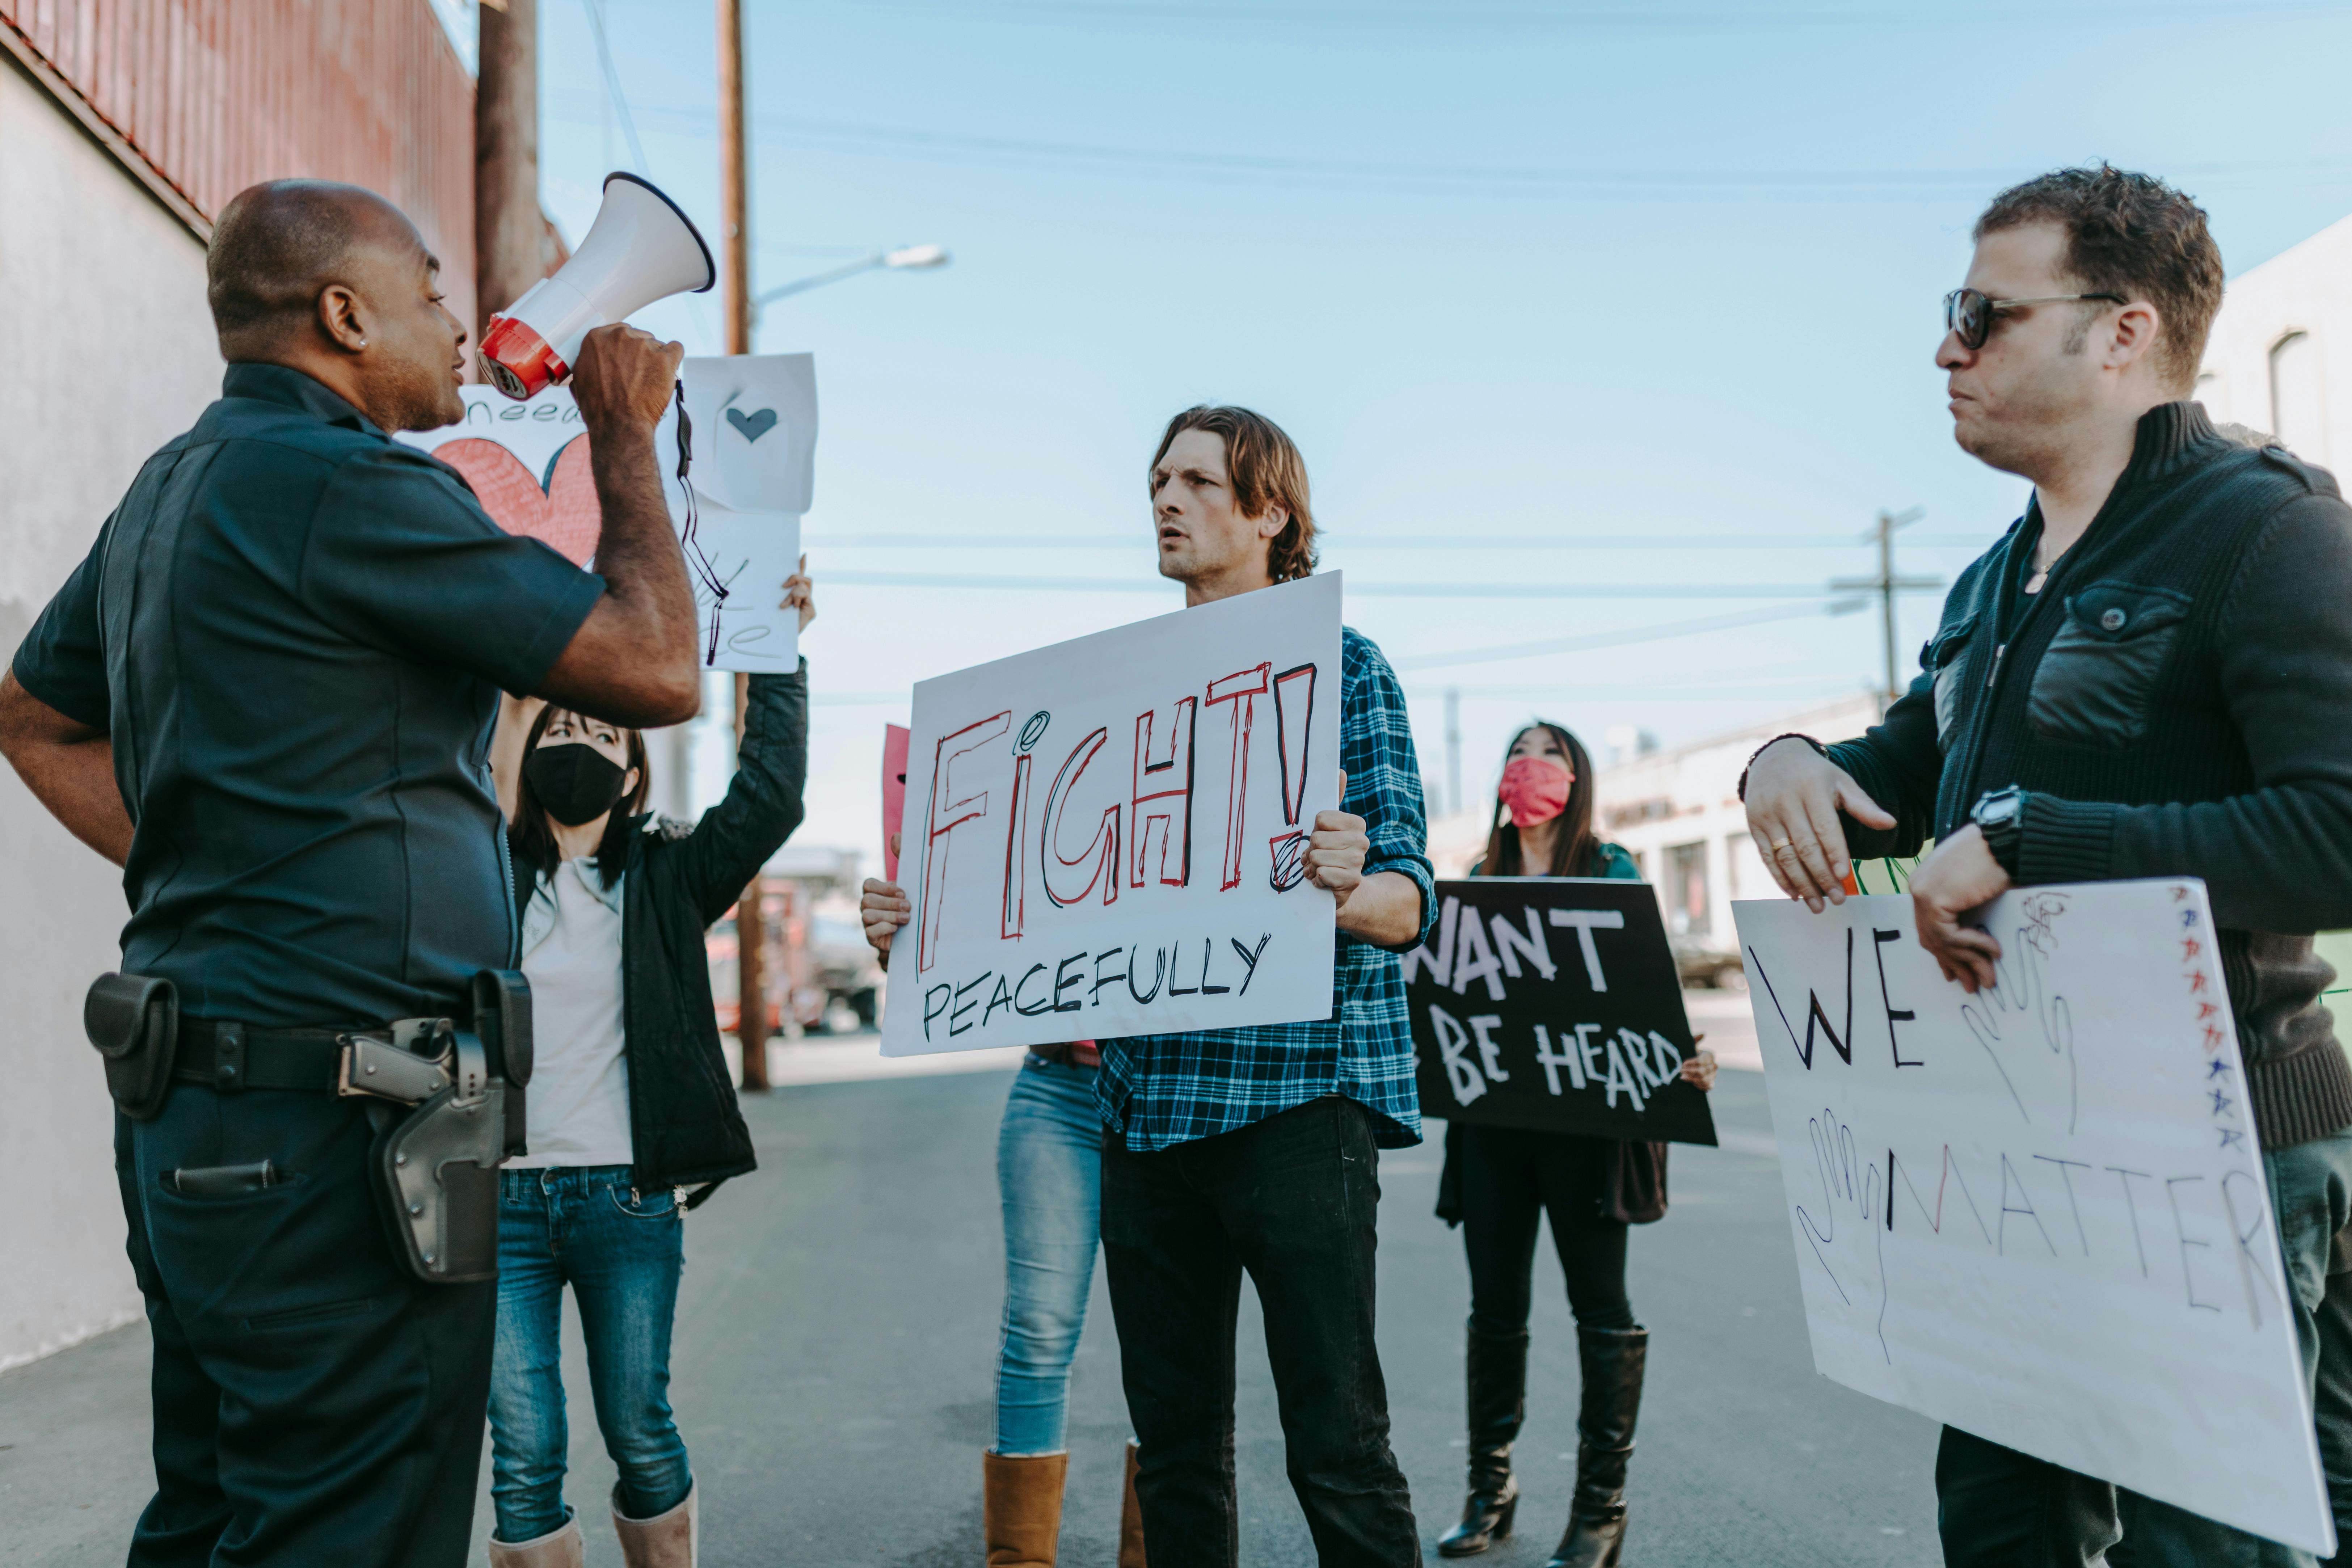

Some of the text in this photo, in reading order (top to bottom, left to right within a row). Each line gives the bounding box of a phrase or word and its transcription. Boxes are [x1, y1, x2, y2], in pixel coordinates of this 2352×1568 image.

[924, 932, 1272, 1042] PEACEFULLY
[1402, 895, 1625, 1001] WANT
[1748, 926, 1925, 1070] WE
[1429, 1004, 1683, 1112] BE HEARD
[1887, 1143, 2282, 1332] MATTER
